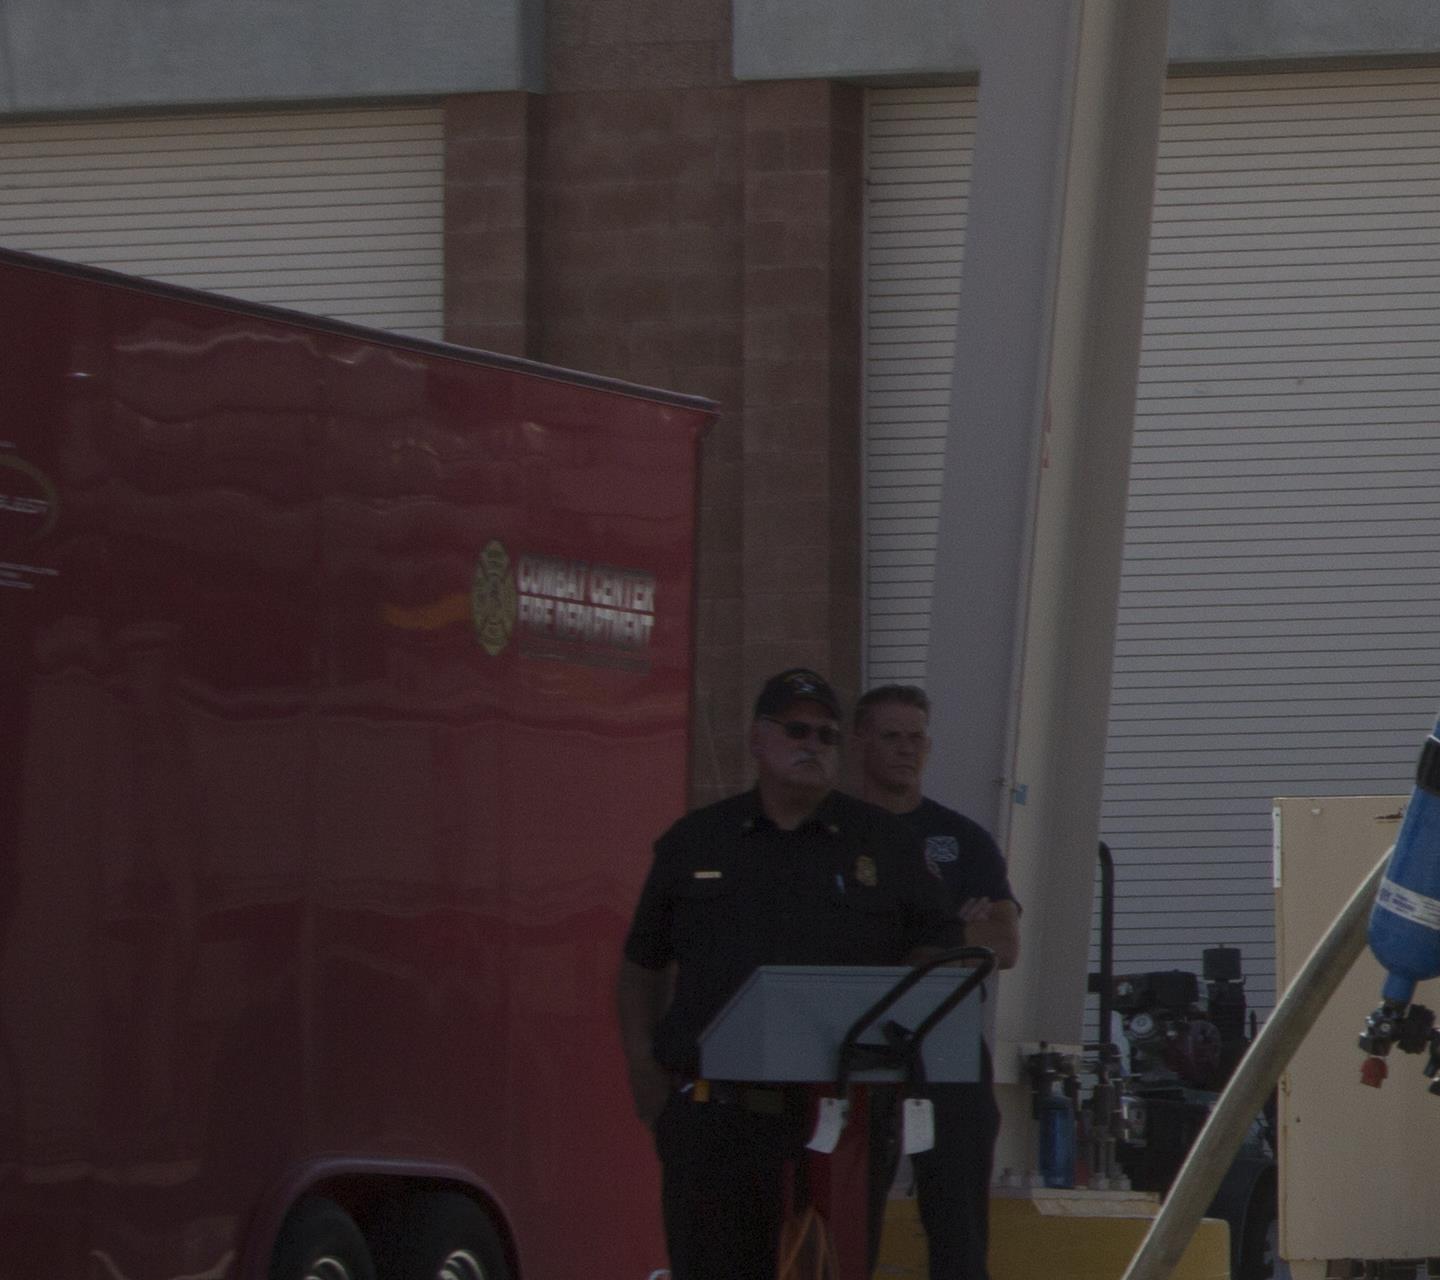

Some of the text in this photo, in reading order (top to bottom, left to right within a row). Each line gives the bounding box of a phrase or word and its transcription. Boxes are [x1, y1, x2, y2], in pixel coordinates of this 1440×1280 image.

[518, 554, 656, 613] COMBAT CENTER
[518, 595, 655, 649] FIRE DEPARTMENT
